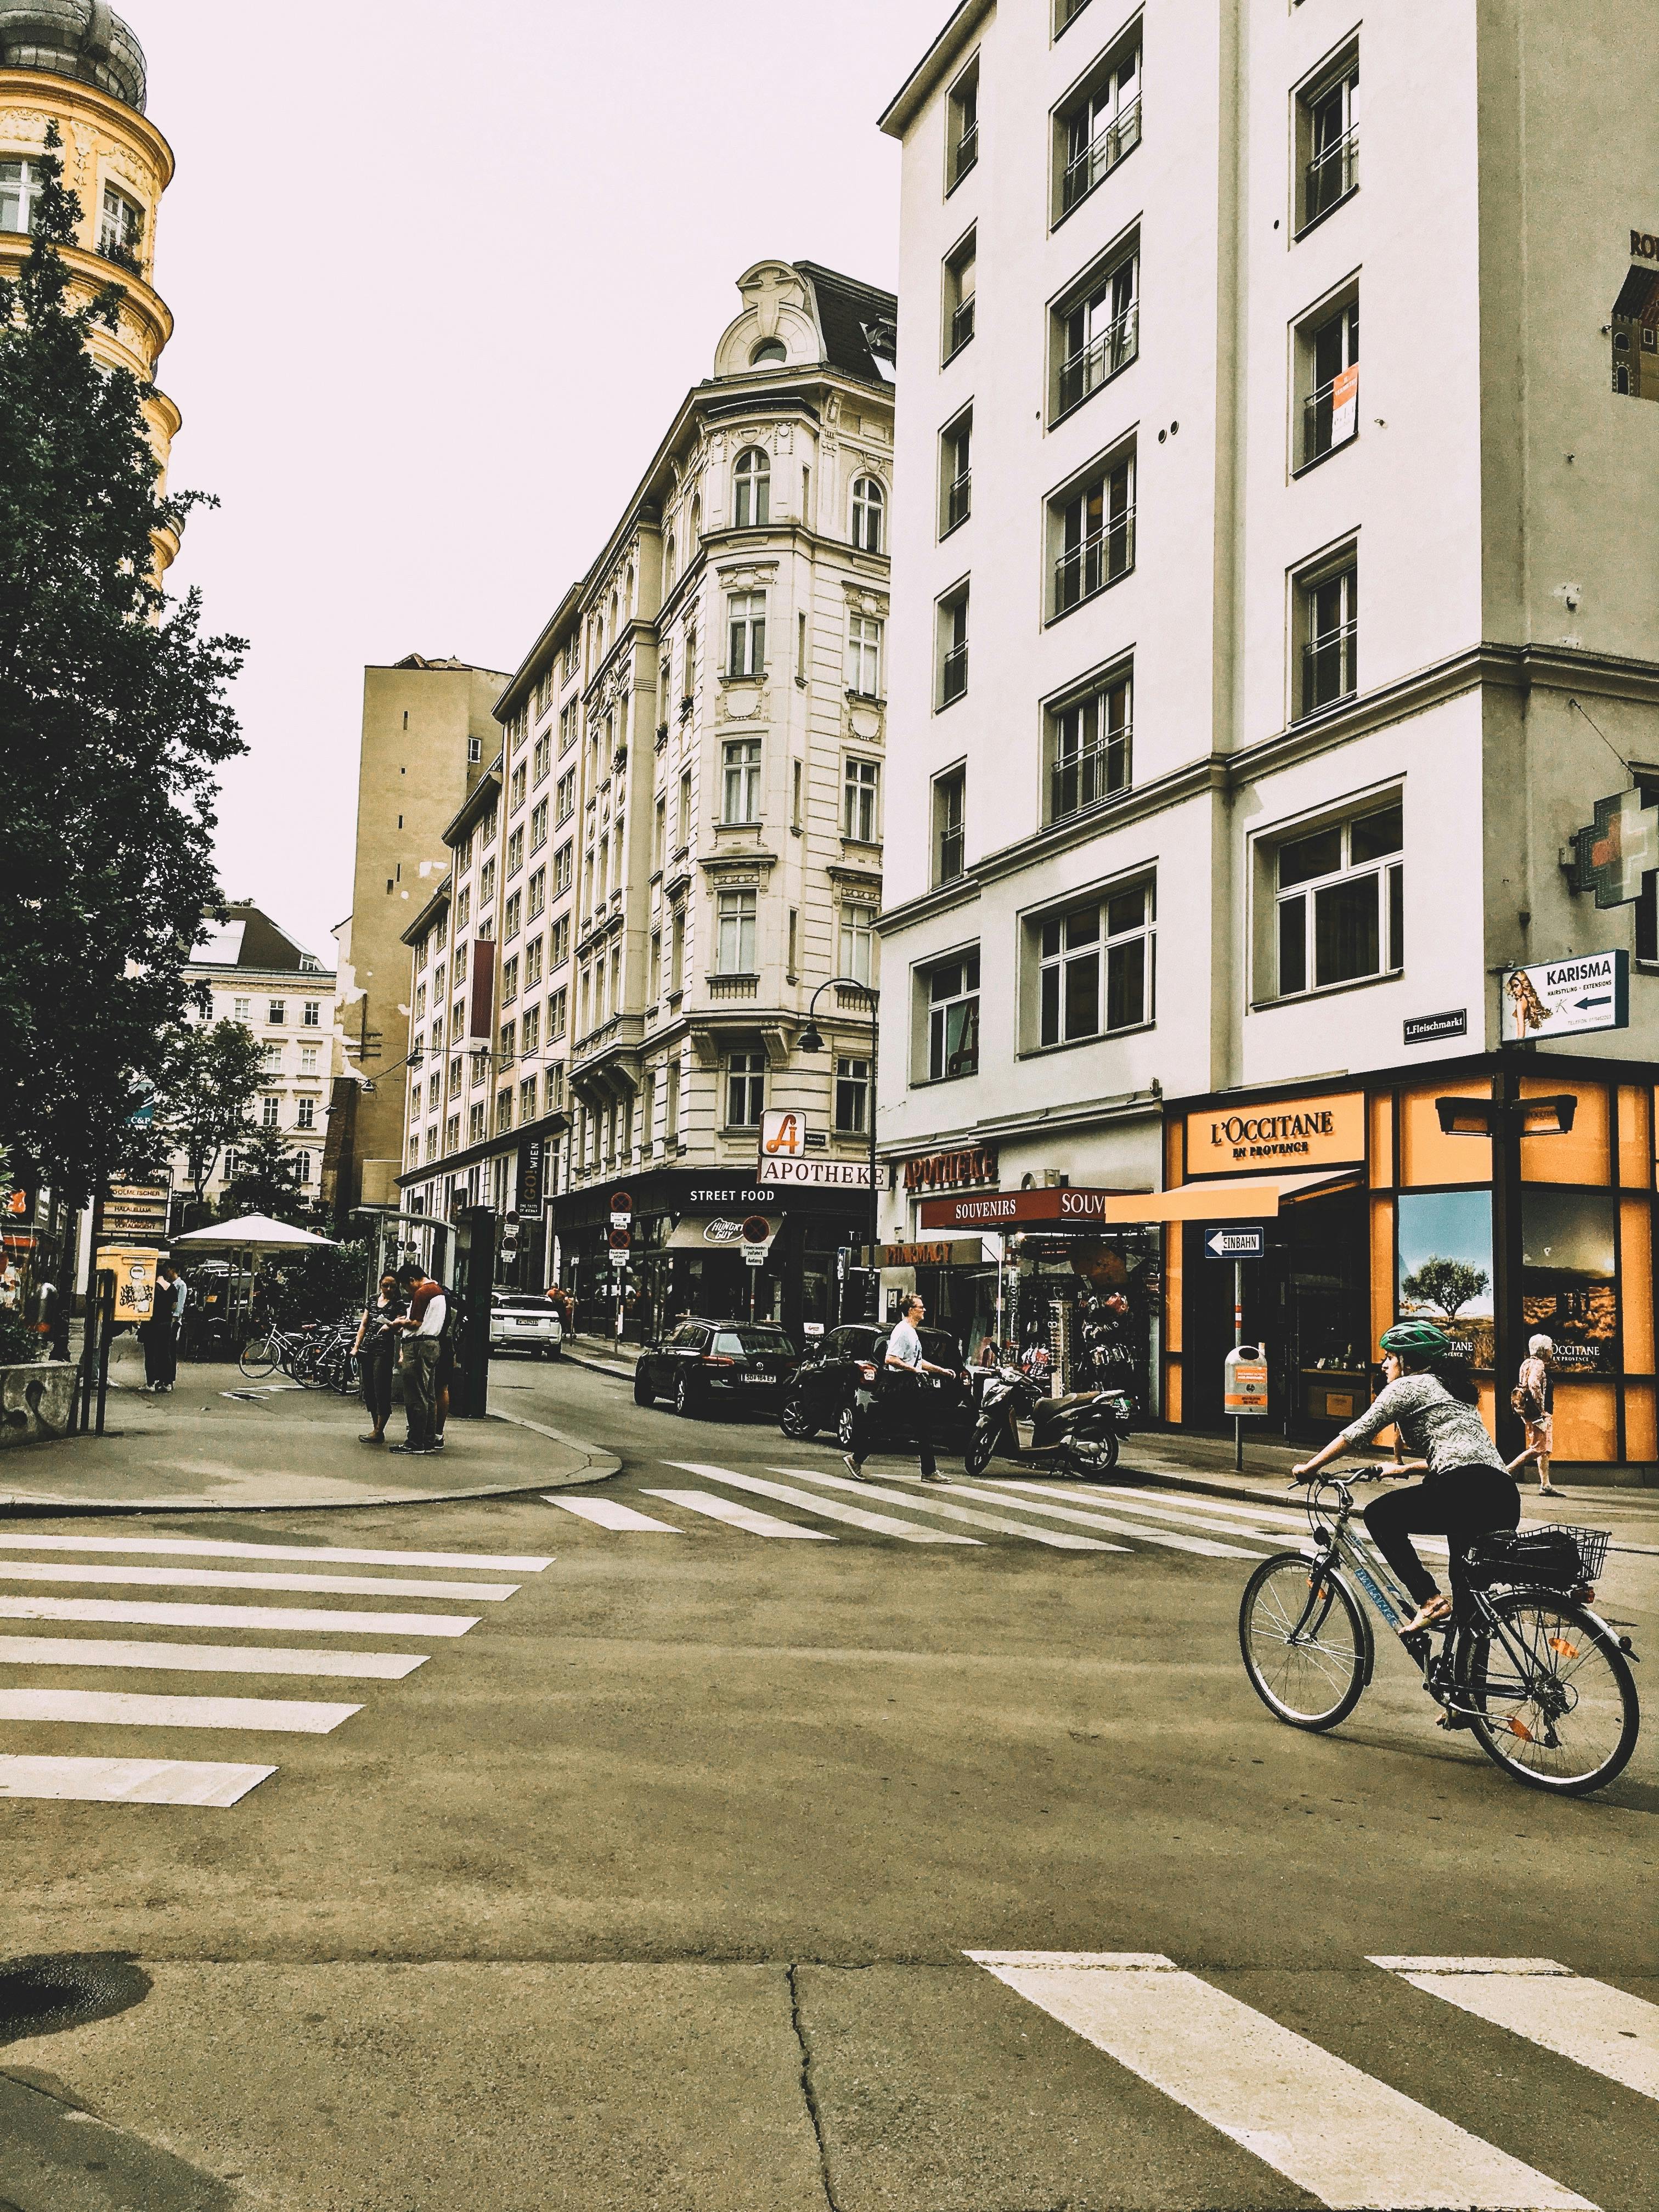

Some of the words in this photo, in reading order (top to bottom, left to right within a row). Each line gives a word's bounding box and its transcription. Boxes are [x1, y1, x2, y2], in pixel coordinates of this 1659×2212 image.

[1547, 960, 1612, 986] KARISMA
[1547, 986, 1578, 996] HAIRSTYLING
[1583, 979, 1612, 991] EXTENSIONS
[131, 1116, 151, 1124] C&P
[1211, 1111, 1333, 1144] L'OCCITANE
[529, 1143, 539, 1169] WIEN
[1233, 1147, 1246, 1158] EN
[1250, 1141, 1308, 1156] PROVENCE
[763, 1161, 884, 1185] APOTHEKE
[902, 1148, 996, 1189] APOTHEKE
[690, 1190, 736, 1201] STREET
[741, 1190, 774, 1201] FOOD
[1062, 1193, 1106, 1214] SOUV
[956, 1199, 1016, 1219] SOUVENIRS
[715, 1230, 733, 1239] GUY
[1223, 1236, 1256, 1249] EINBAHN
[887, 1242, 953, 1265] PHARMACY
